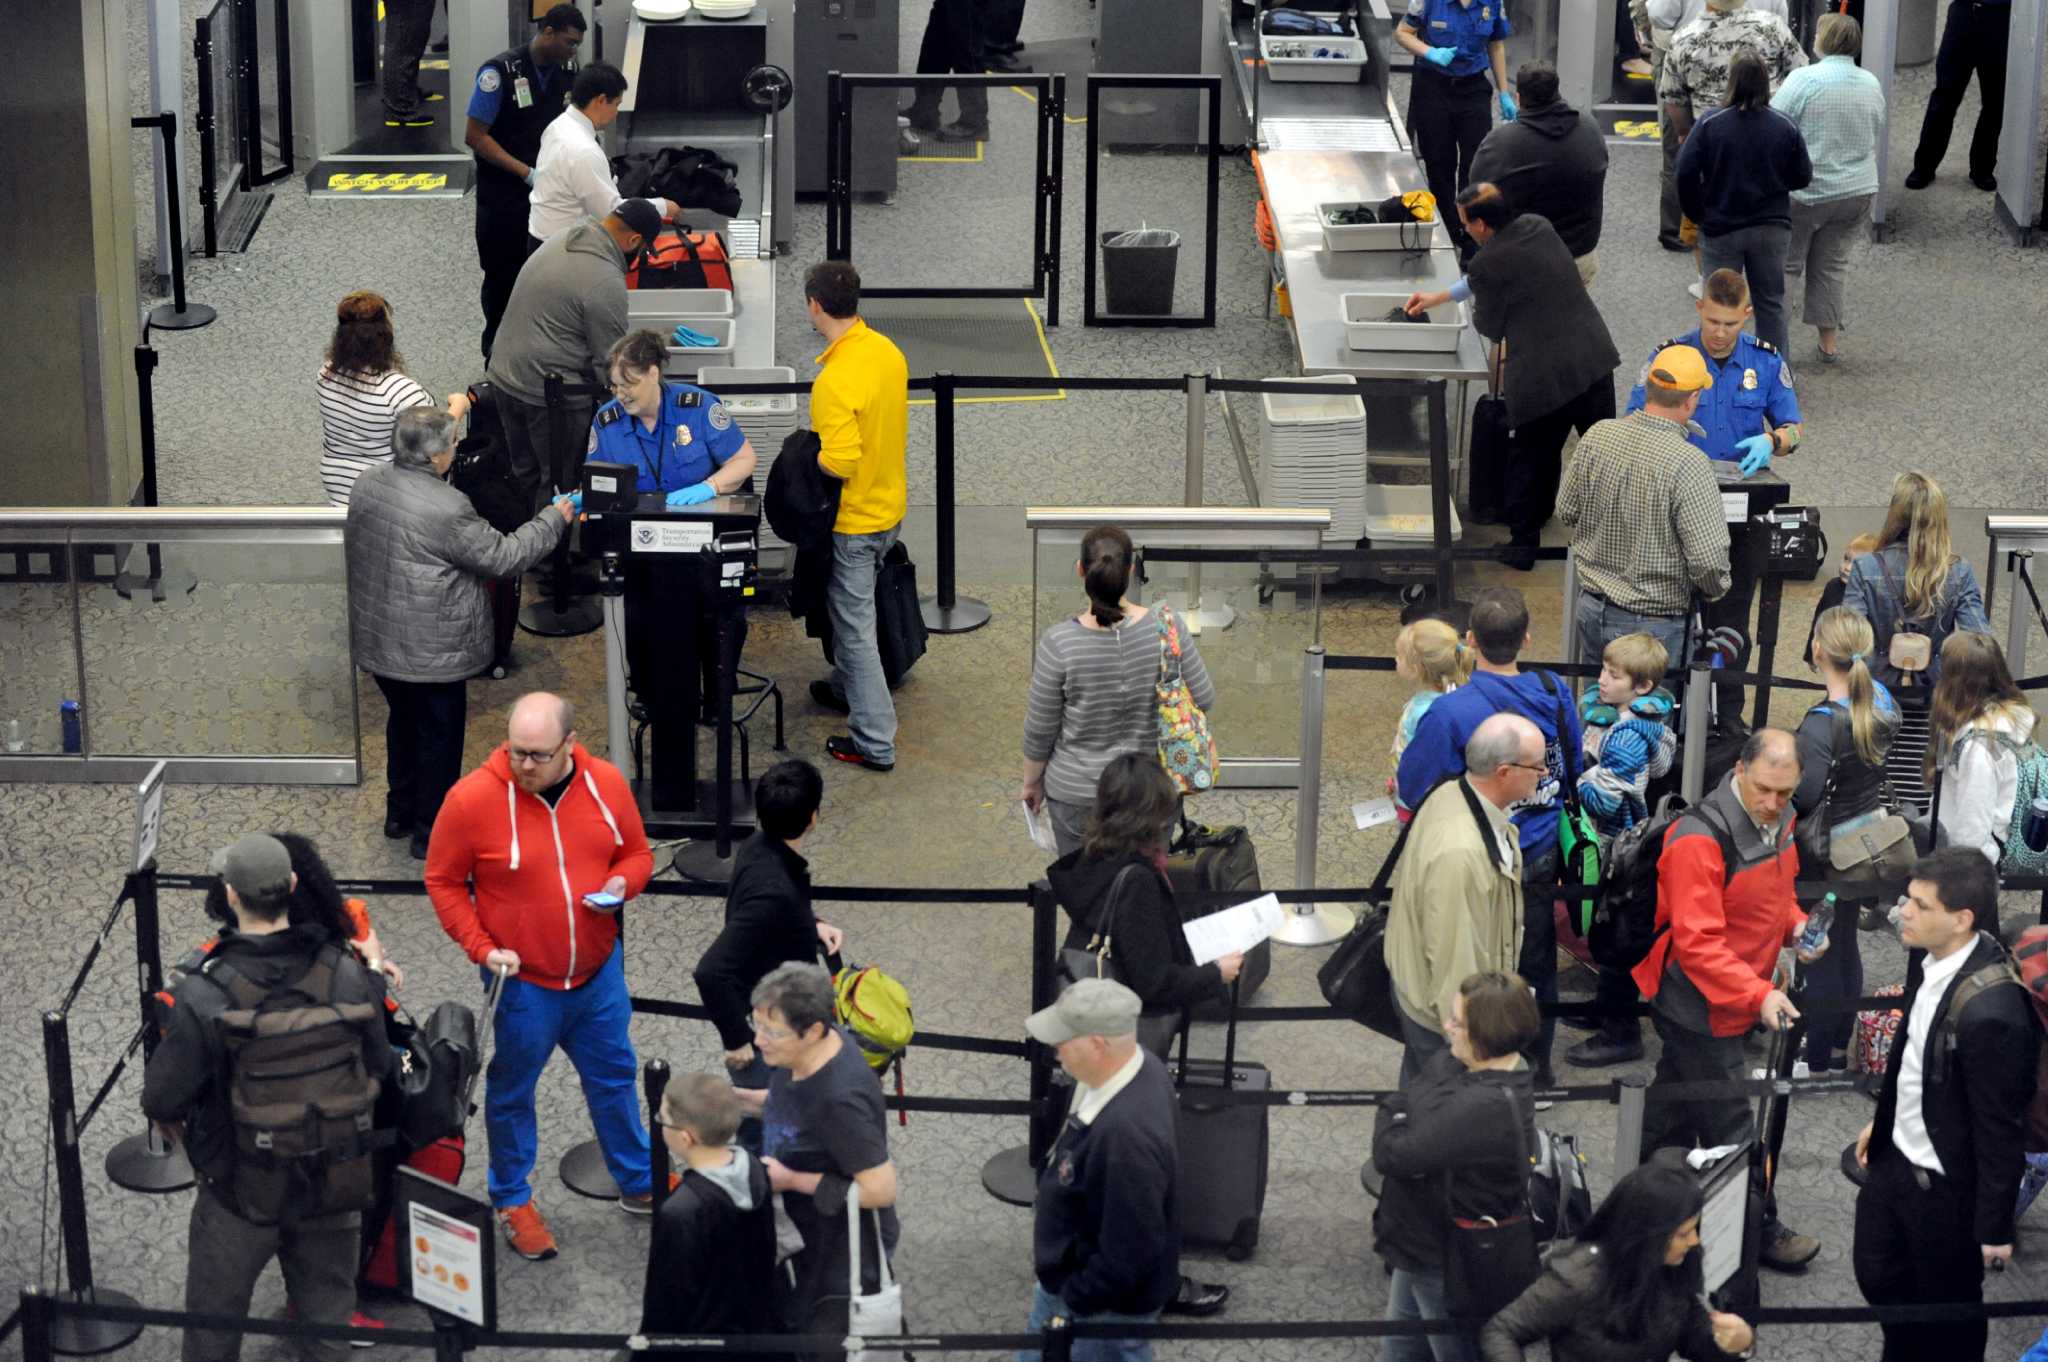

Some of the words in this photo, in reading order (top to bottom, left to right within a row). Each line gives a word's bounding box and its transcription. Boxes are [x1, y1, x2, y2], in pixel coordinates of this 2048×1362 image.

[334, 178, 374, 186] WATCH
[377, 178, 410, 186] YOUR
[411, 178, 442, 186] STEP
